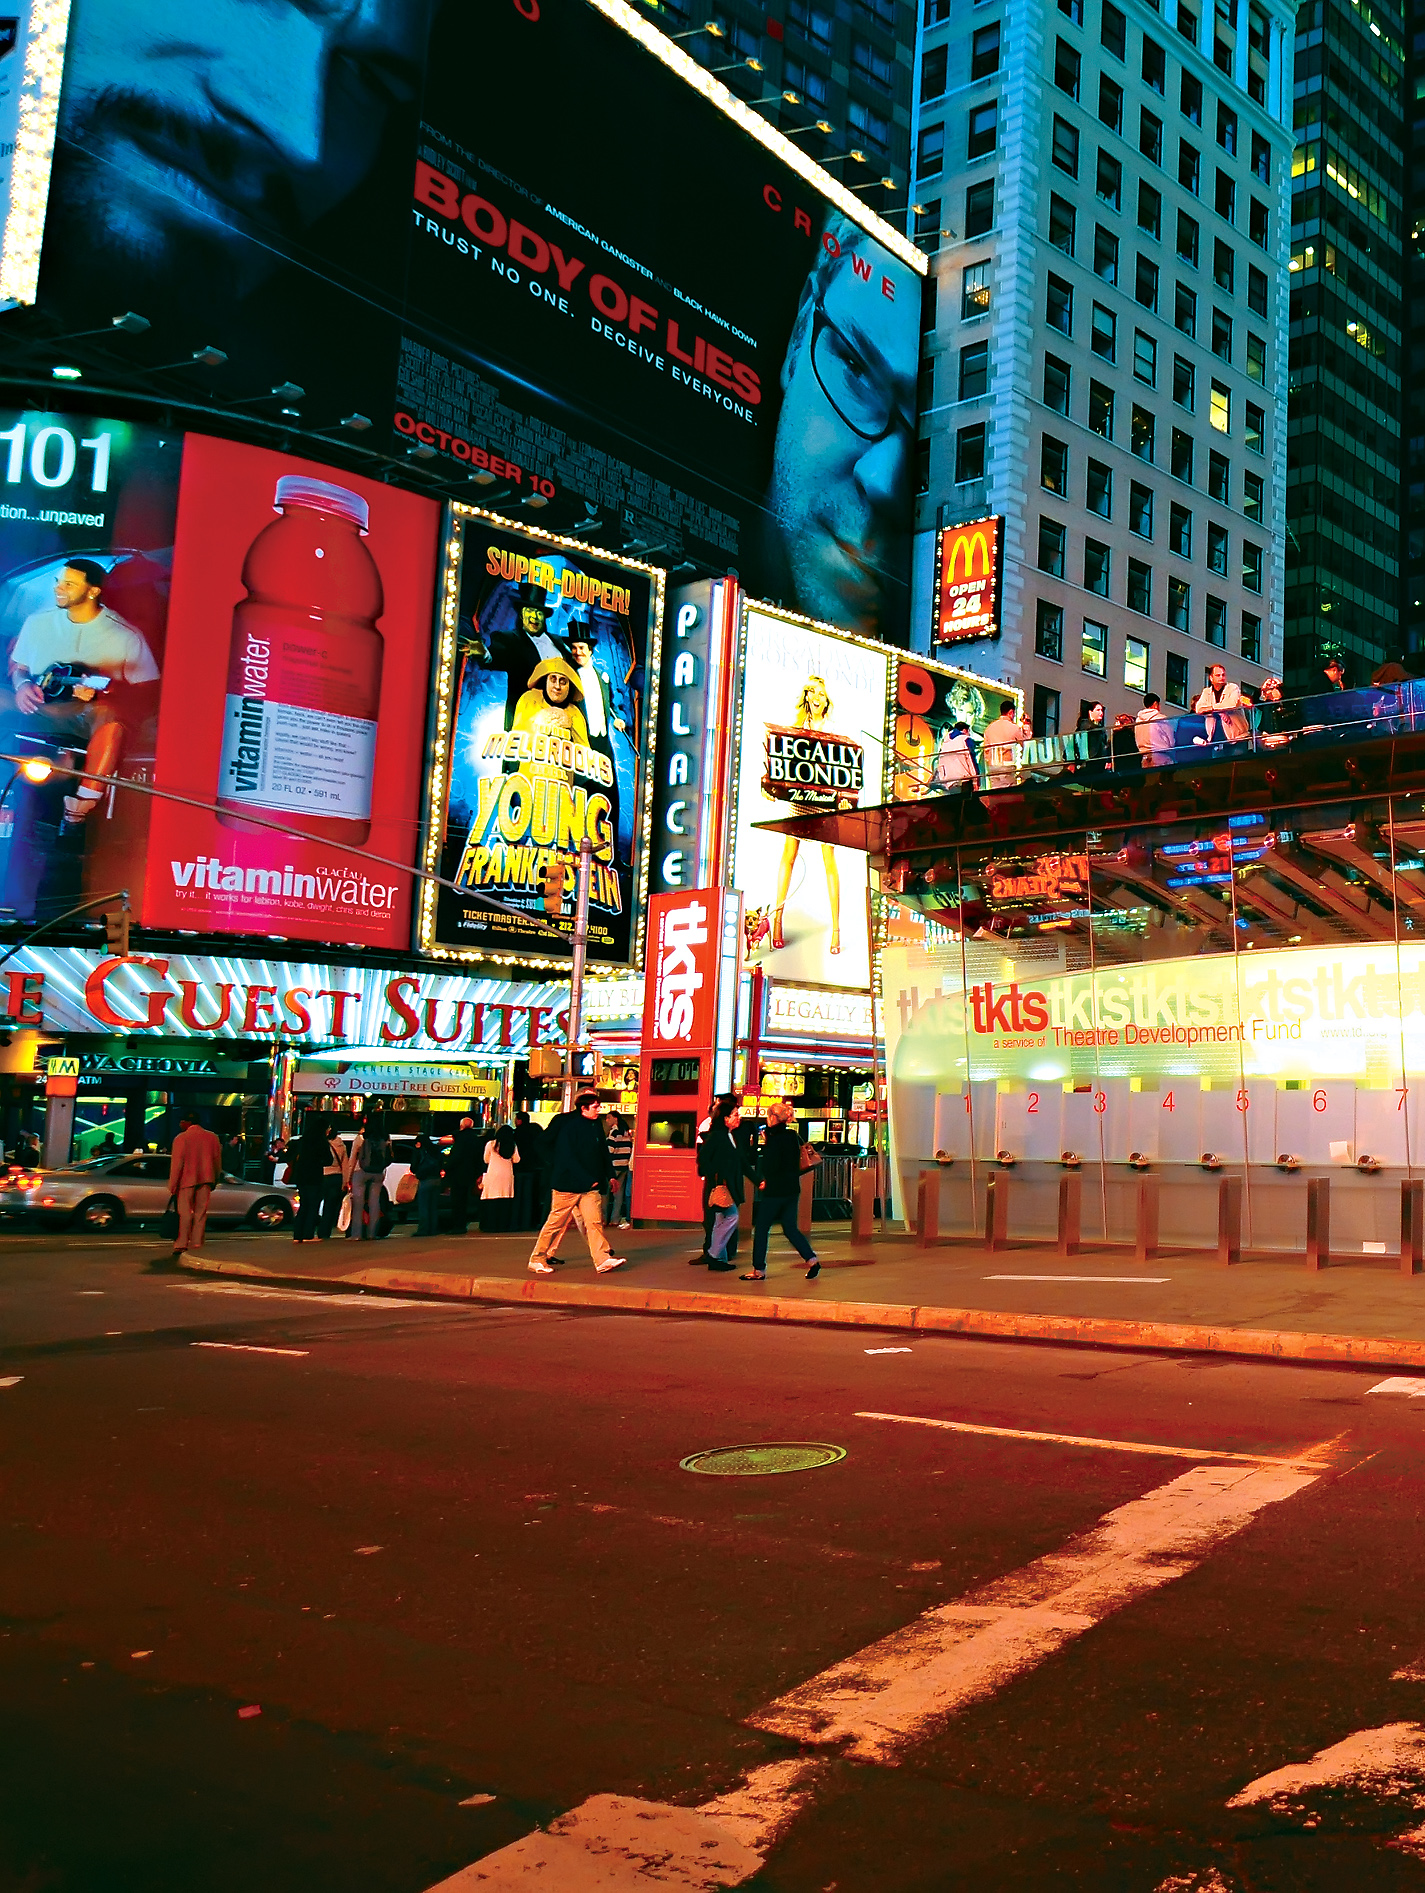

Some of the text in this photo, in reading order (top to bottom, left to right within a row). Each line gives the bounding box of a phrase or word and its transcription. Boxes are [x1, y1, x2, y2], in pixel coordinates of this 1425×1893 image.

[420, 120, 452, 148] FROM
[455, 143, 476, 164] THE
[478, 158, 529, 198] DIRECTOR
[544, 203, 600, 245] AMERICAN
[600, 239, 654, 281] GANGSTER
[654, 276, 673, 293] AND
[673, 287, 704, 314] BLACK
[704, 302, 731, 332] HAWK
[731, 324, 758, 349] DOWN
[763, 184, 896, 302] CROWE
[413, 159, 762, 405] BODY OF LIES
[412, 208, 759, 427] TRUST NO ONE. DECEIVE EVERYONE.
[0, 423, 111, 492] 101
[394, 411, 522, 485] OCTOBER
[529, 474, 556, 499] 10
[485, 546, 632, 616] SUPER-DUPER!
[949, 579, 987, 598] OPEN
[952, 593, 982, 618] 24
[943, 612, 990, 634] HOURS
[480, 731, 614, 788] MEL BROOKS
[662, 602, 699, 886] PALACE
[769, 734, 863, 768] LEGALLY
[770, 756, 864, 790] BLONDE
[284, 785, 293, 793] FL
[295, 787, 306, 795] OZ
[313, 788, 328, 798] 591
[788, 788, 836, 802] The Musical
[469, 773, 614, 863] YOUNG
[171, 856, 399, 909] vitaminwater
[175, 888, 188, 900] try
[205, 892, 211, 900] it
[213, 893, 239, 903] works
[240, 894, 252, 904] for
[336, 904, 354, 915] chris
[355, 906, 369, 917] and
[370, 908, 391, 919] deron
[660, 901, 708, 1041] tkts
[85, 956, 362, 1038] GUEST
[381, 975, 570, 1047] SUITES
[775, 997, 857, 1023] LEGALLY
[970, 982, 1049, 1034] tkts
[993, 1018, 1302, 1050] a service of Theatre Development Fund
[81, 1053, 220, 1075] WACHOVIA
[354, 1064, 400, 1074] CENTER
[409, 1066, 442, 1076] STAGE
[78, 1076, 102, 1085] ATM
[430, 1081, 460, 1094] GUEST
[462, 1082, 487, 1095] SUITES
[1027, 1092, 1040, 1114] 2
[1093, 1091, 1107, 1113] 3
[1162, 1091, 1176, 1112] 4
[1236, 1089, 1250, 1112] 5
[1313, 1089, 1328, 1112] 6
[1396, 1089, 1408, 1112] 7
